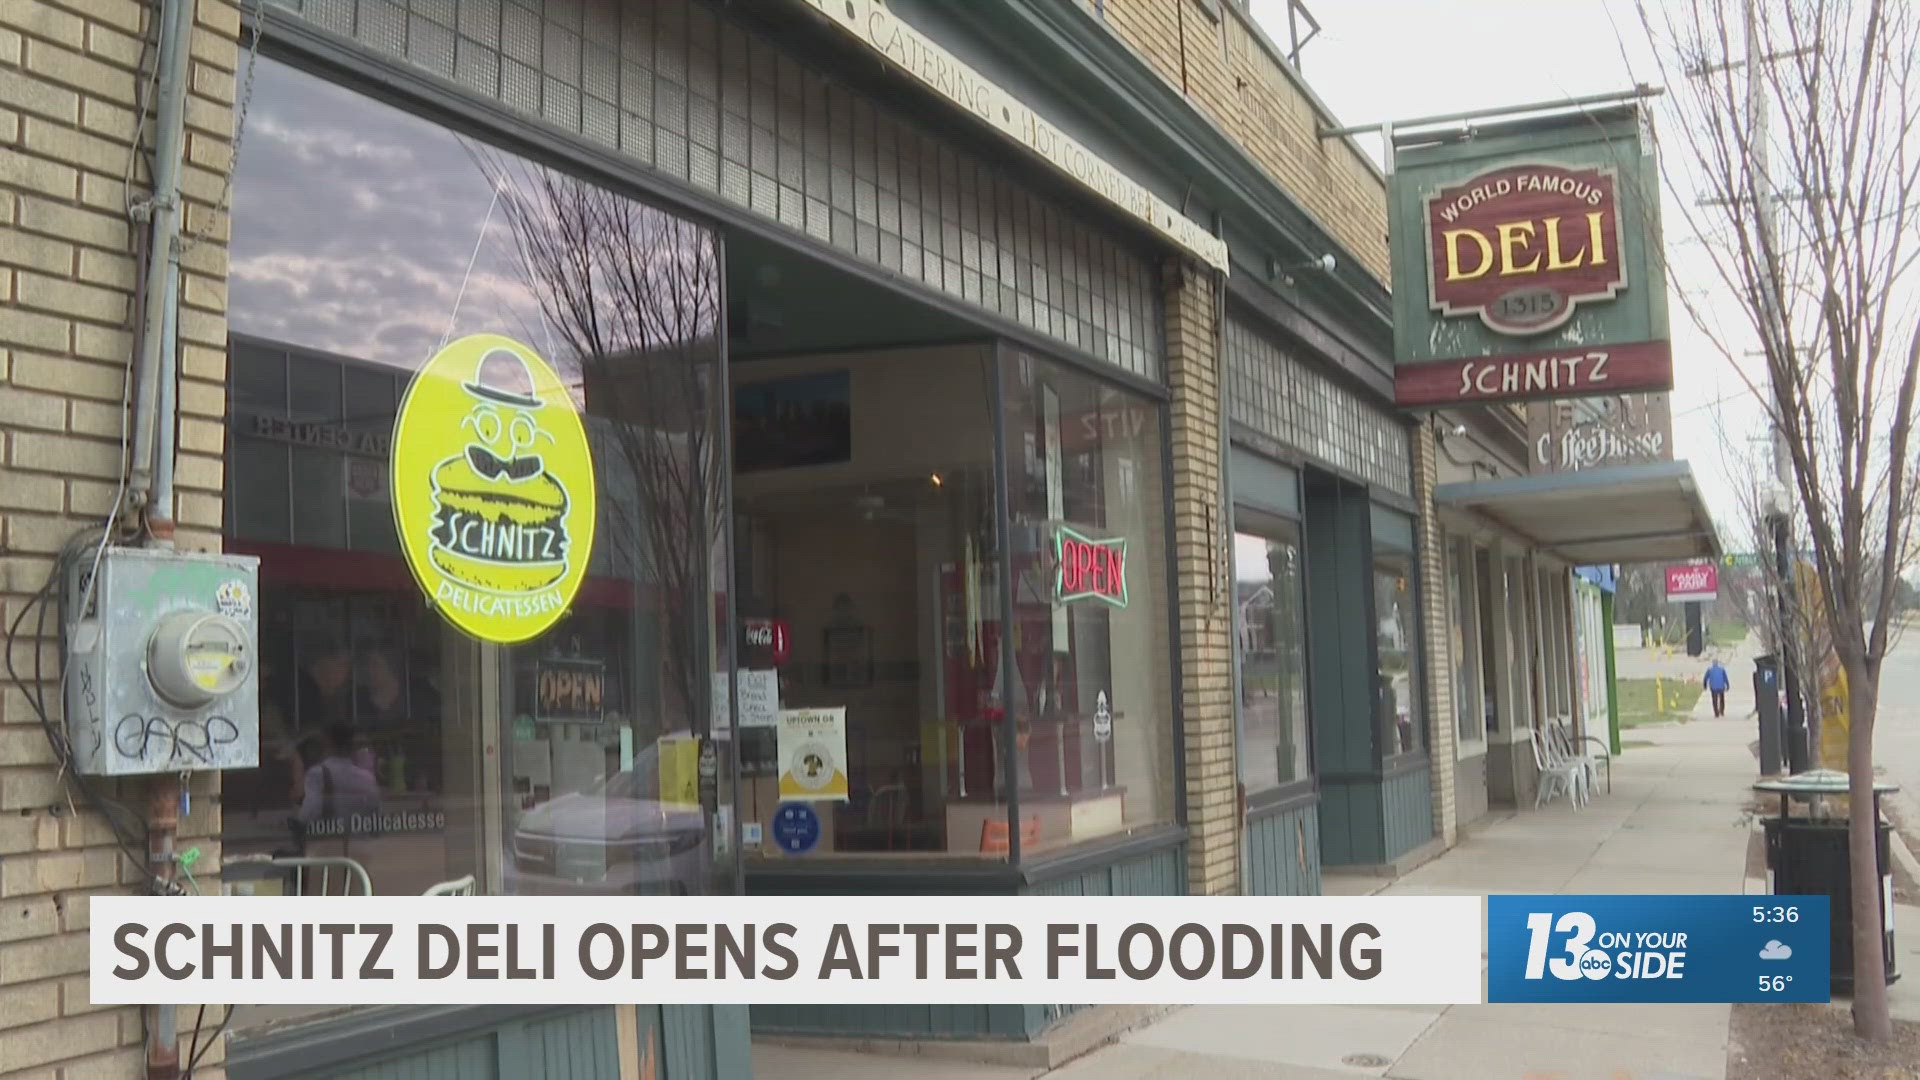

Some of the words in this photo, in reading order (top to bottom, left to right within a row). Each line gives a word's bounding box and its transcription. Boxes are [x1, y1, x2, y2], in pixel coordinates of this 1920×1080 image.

[867, 10, 991, 119] CATERING
[1021, 109, 1058, 162] HOT
[1064, 142, 1127, 205] CORNED
[1440, 178, 1511, 223] WORLD
[1516, 174, 1603, 206] FAMOUS
[1441, 211, 1609, 282] DELI
[1502, 293, 1555, 316] 1315
[1459, 352, 1610, 395] SCHNITZ
[448, 512, 556, 559] SCHNITZ
[1062, 538, 1123, 596] OPEN
[435, 582, 564, 619] DELICATESSEN
[540, 669, 601, 714] OPEN
[786, 714, 821, 726] UPTOWN
